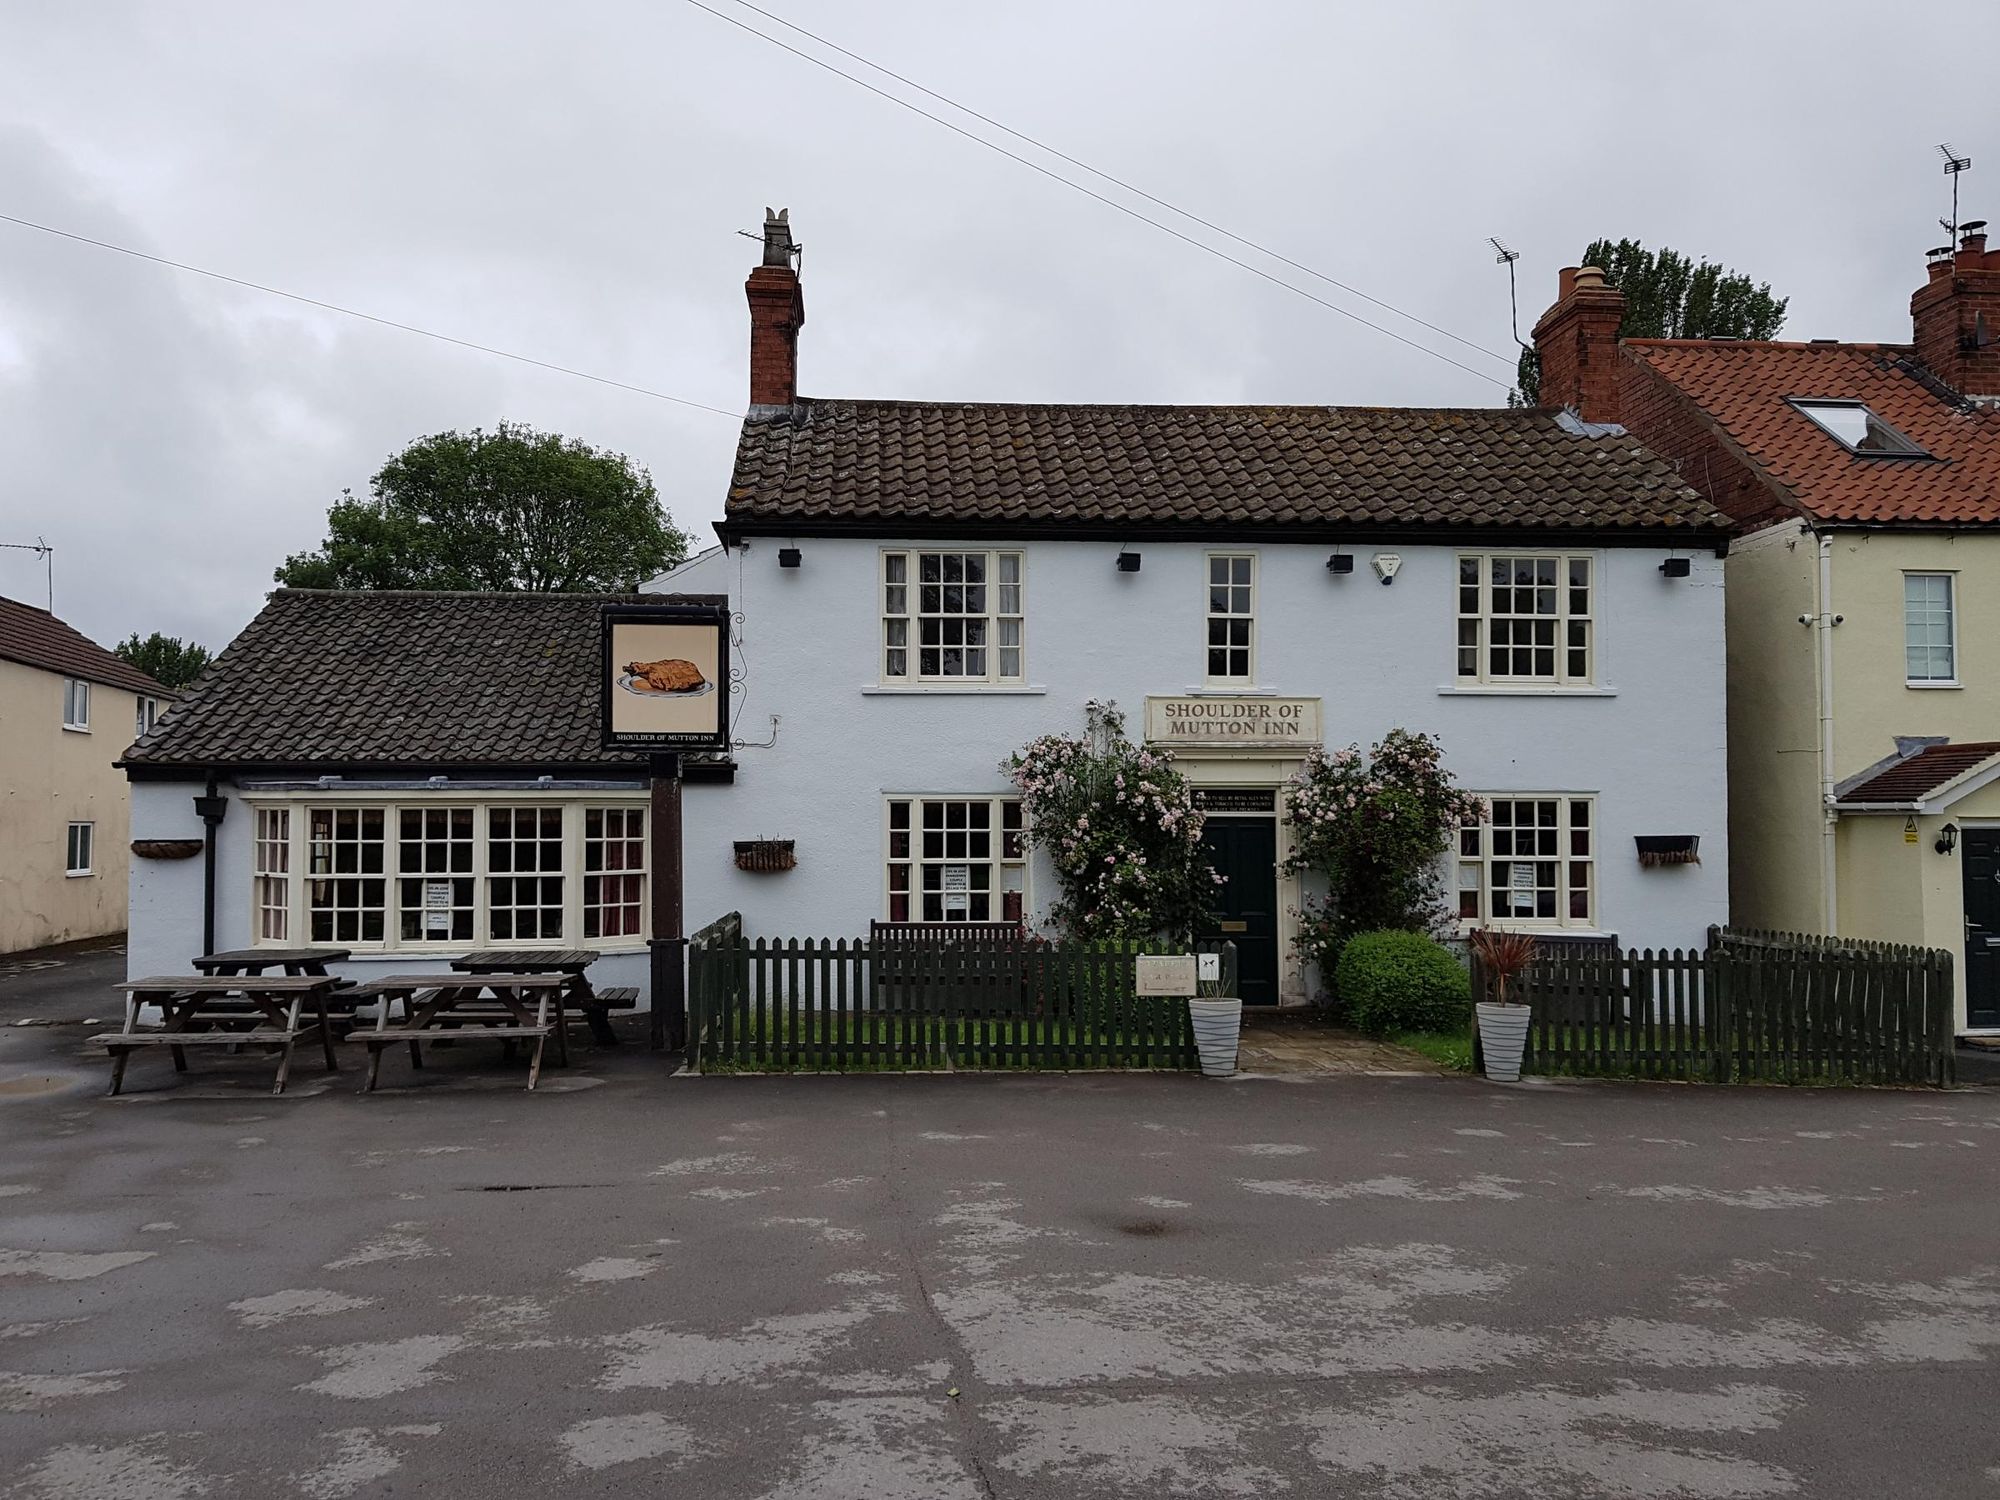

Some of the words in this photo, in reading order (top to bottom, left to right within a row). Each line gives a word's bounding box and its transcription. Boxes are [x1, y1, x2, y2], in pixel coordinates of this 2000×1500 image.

[1165, 703, 1272, 718] SHOULDER
[1278, 704, 1304, 719] OF
[1170, 721, 1256, 735] MUTTON
[1264, 721, 1299, 735] INN
